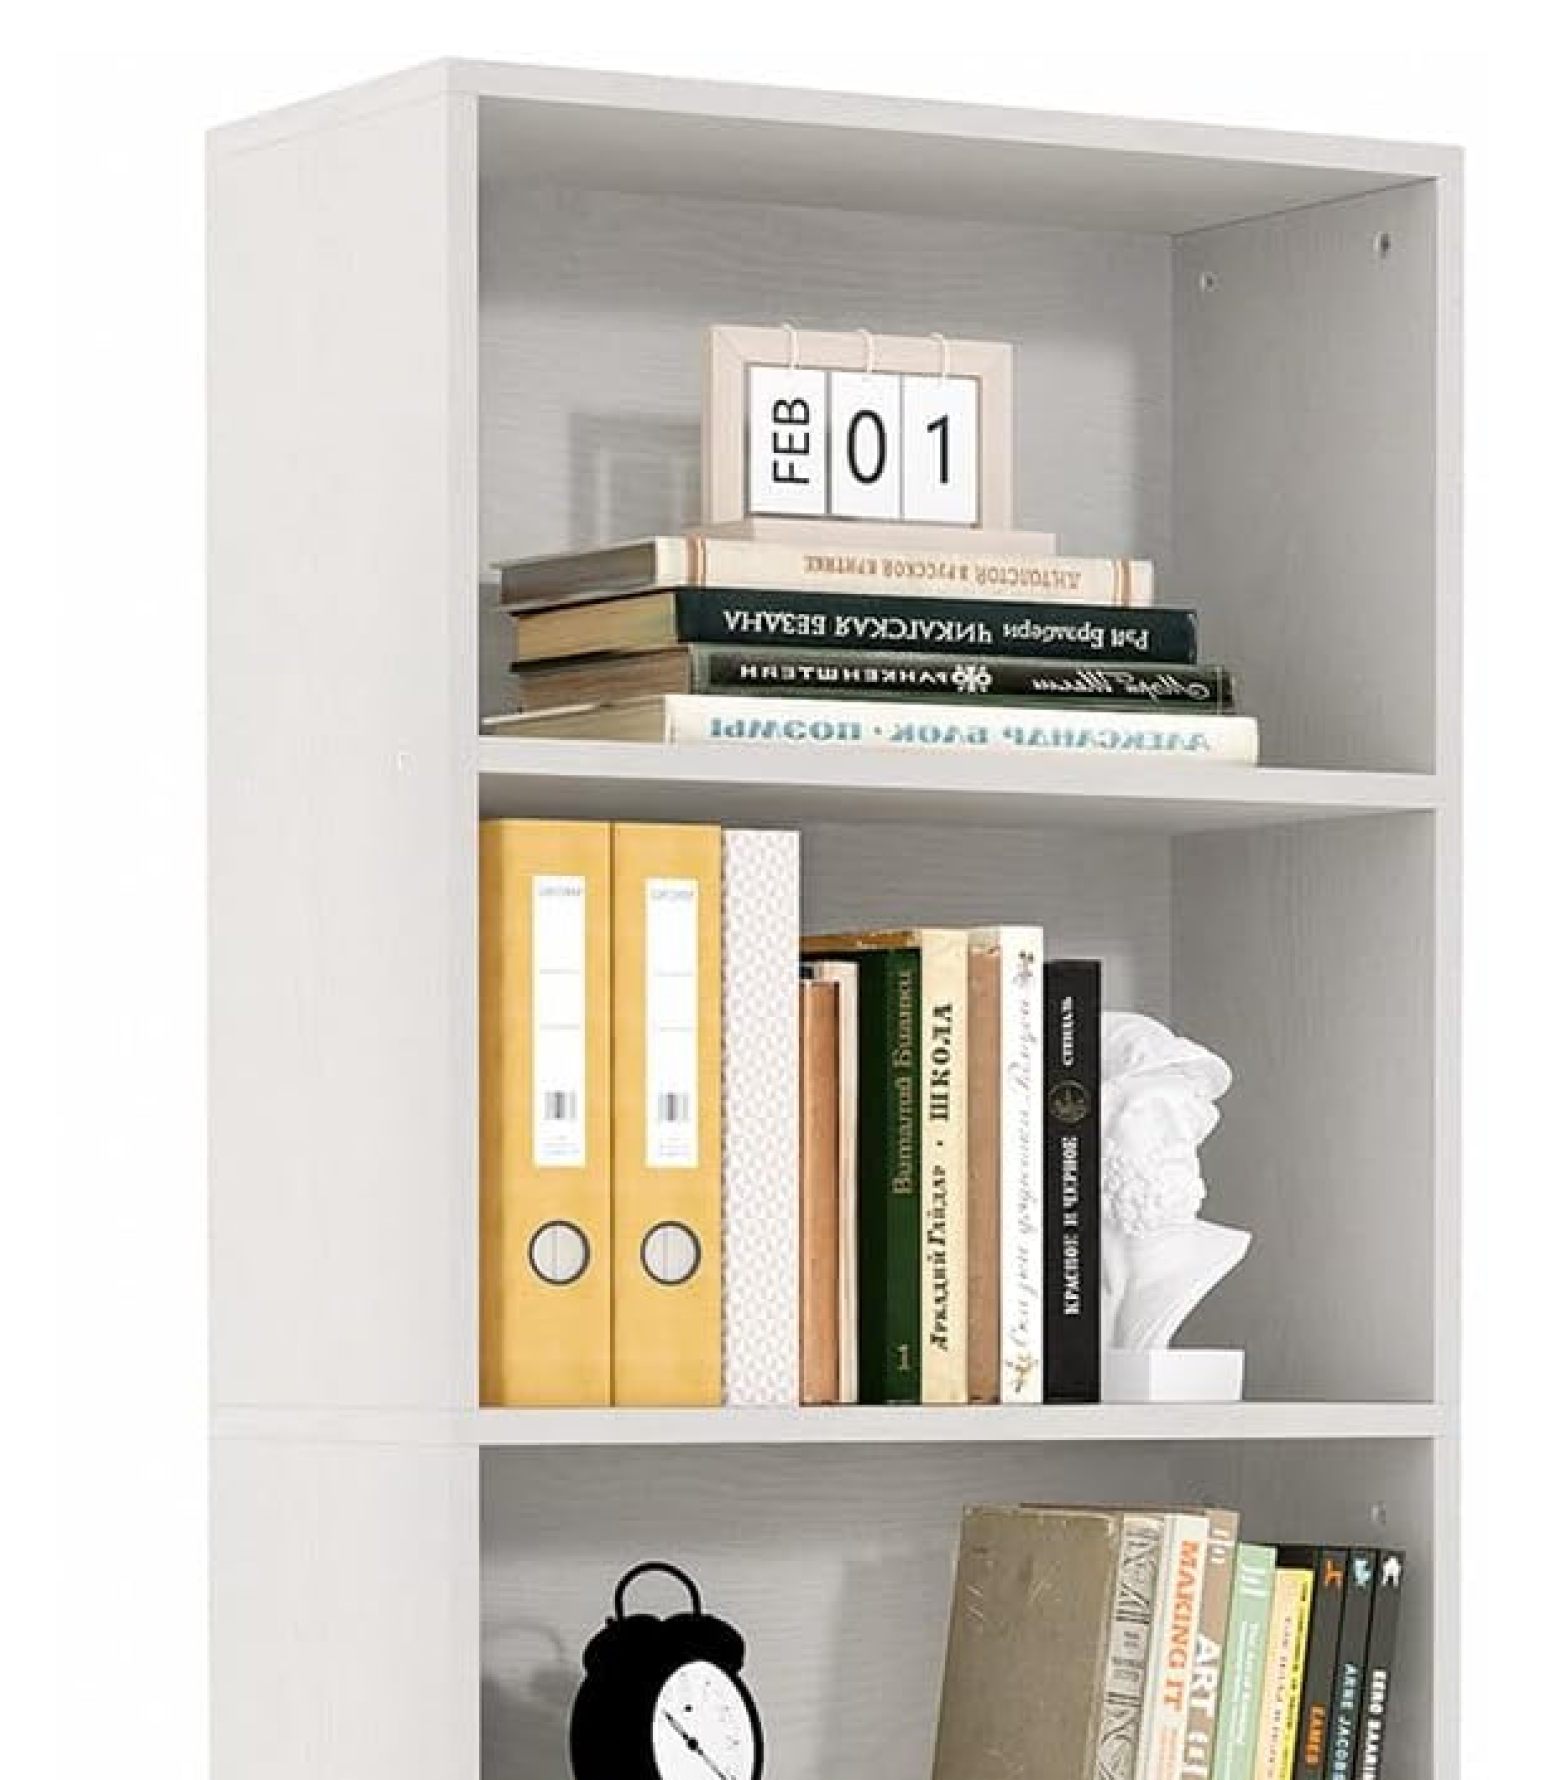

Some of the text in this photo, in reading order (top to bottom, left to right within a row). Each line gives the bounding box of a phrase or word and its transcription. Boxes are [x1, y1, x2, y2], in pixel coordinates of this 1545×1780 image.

[772, 396, 811, 486] FEB
[723, 610, 1150, 651] Рэй Брэдбери ЧИКАГСКАЯ БЕЗДНА
[929, 1003, 954, 1122] ШКОЛА
[1062, 1232, 1080, 1315] КРАСНОЕ
[1163, 1540, 1199, 1712] MAKING IT
[1190, 1631, 1222, 1718] ART
[1340, 1663, 1358, 1710] ARNE
[1369, 1669, 1388, 1715] EERO
